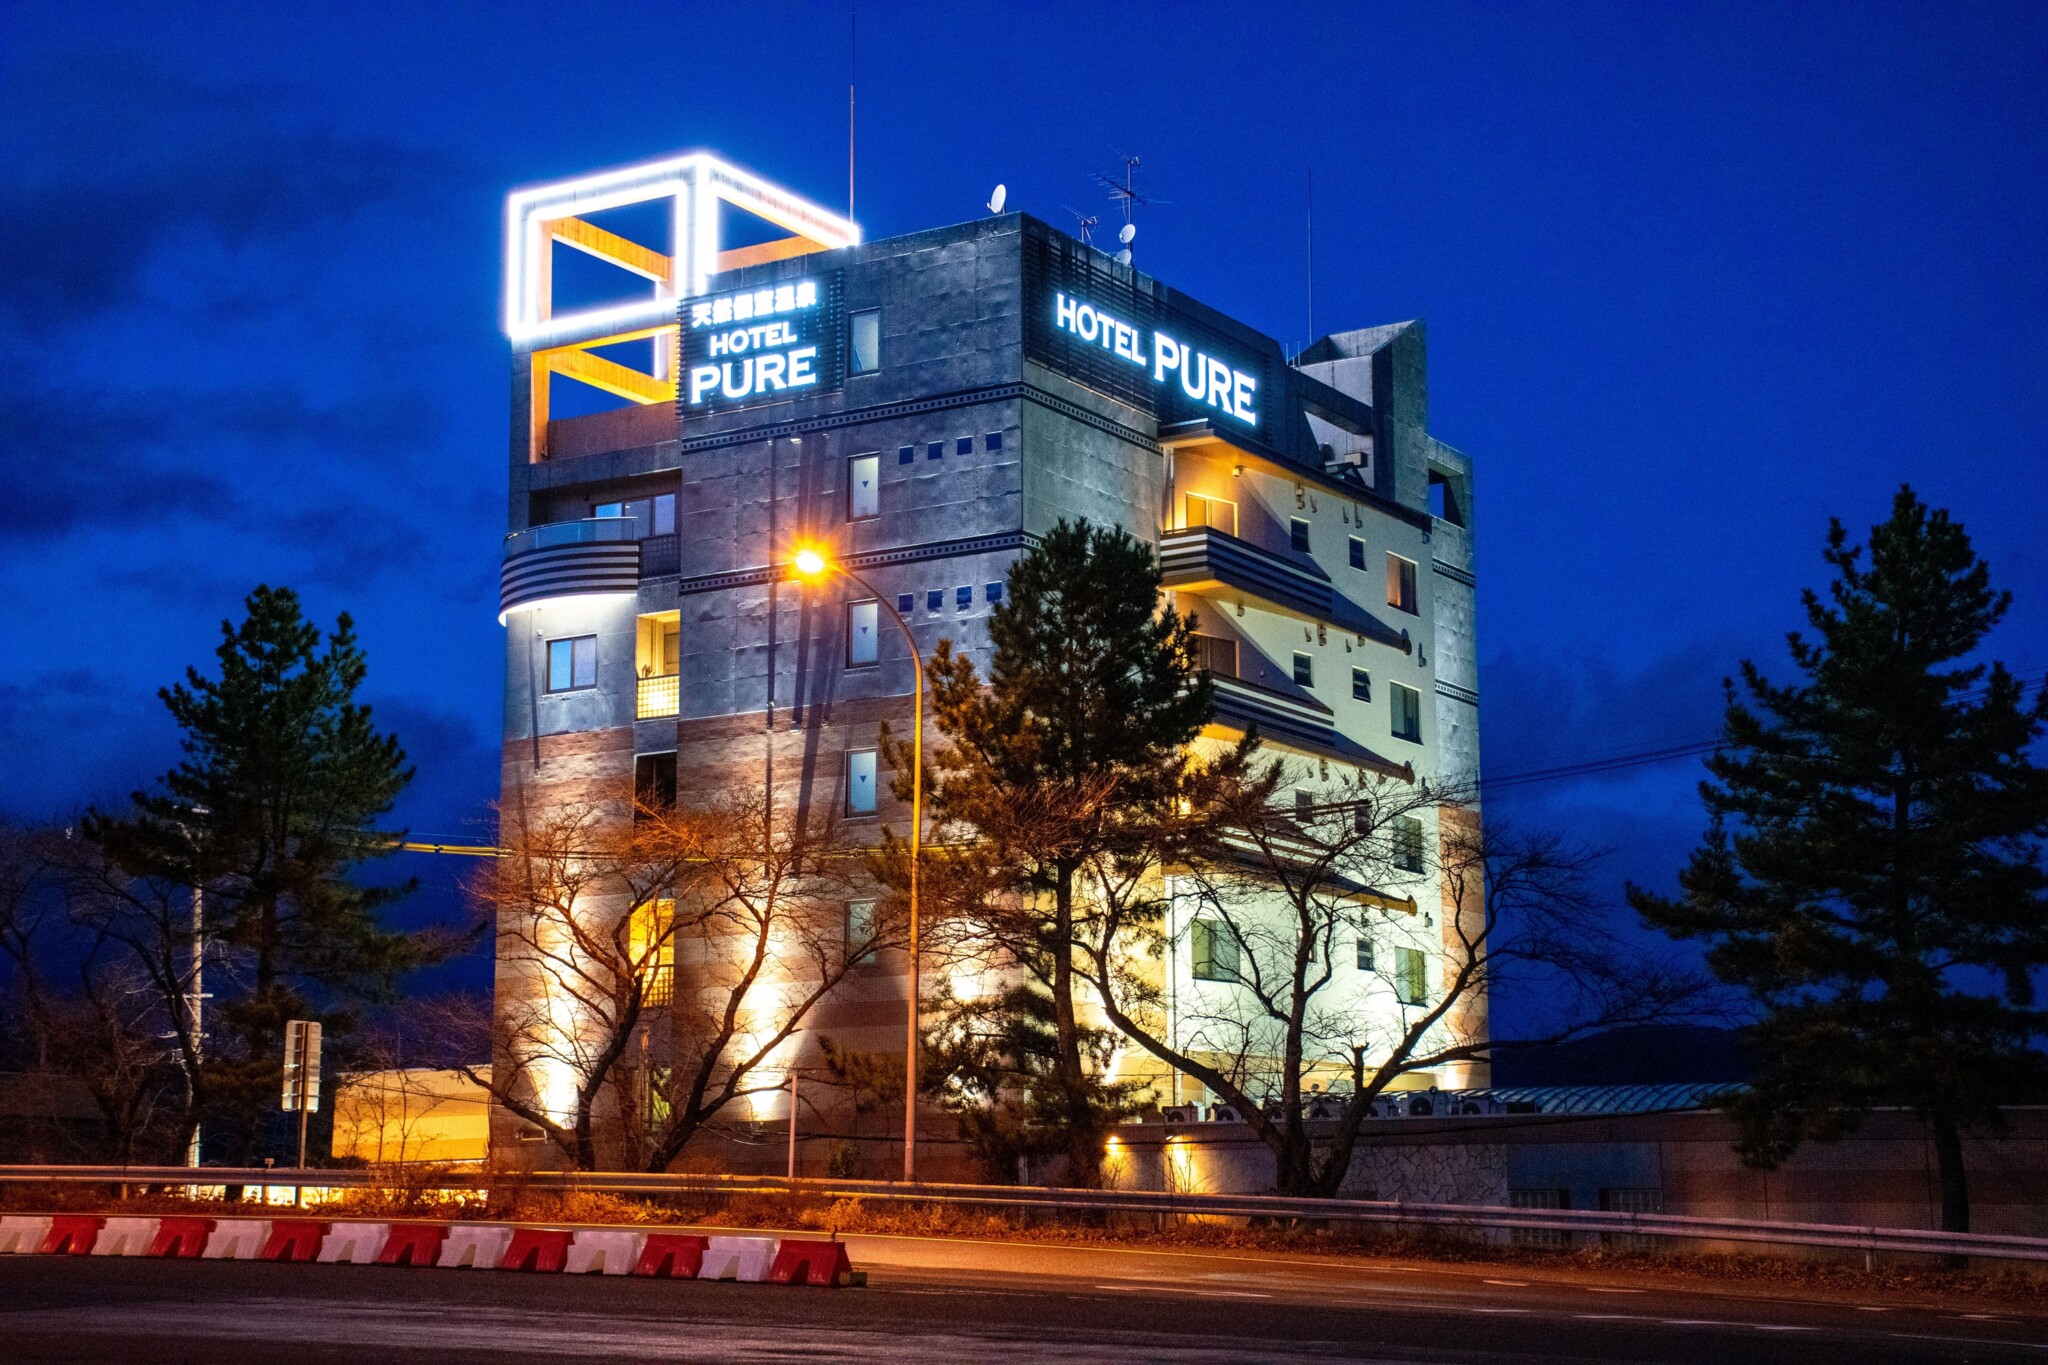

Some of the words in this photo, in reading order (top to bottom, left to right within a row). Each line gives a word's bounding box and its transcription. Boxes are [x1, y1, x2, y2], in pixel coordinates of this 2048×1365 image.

[710, 321, 797, 357] HOTEL
[1056, 292, 1147, 367] HOTEL
[1154, 331, 1256, 426] PURE
[690, 346, 816, 404] PURE
